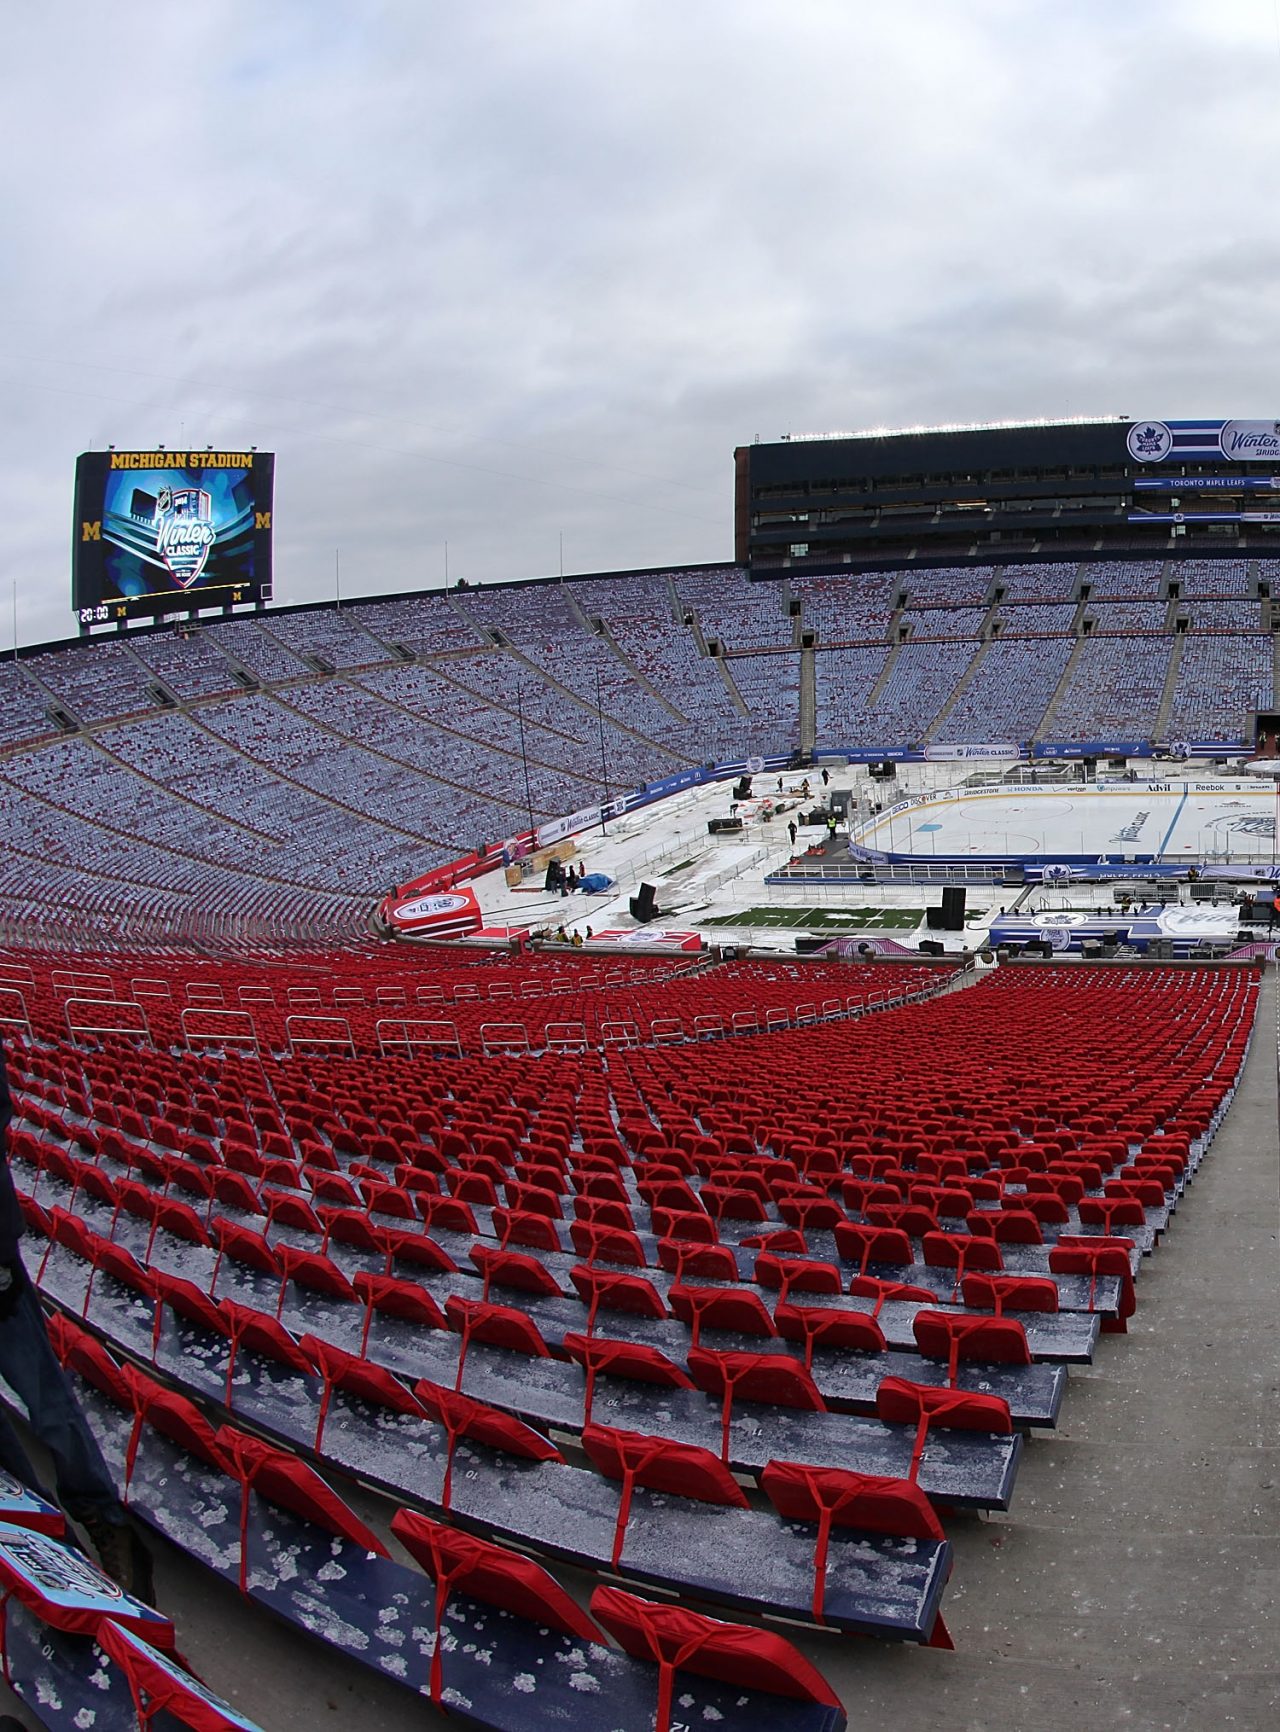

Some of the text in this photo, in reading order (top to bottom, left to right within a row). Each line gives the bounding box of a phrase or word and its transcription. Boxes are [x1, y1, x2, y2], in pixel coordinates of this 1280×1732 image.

[1229, 431, 1280, 451] Winter
[111, 454, 253, 469] MICHIGAN STADIUM
[255, 512, 271, 529] M
[82, 522, 101, 541] M
[157, 517, 215, 554] Winter
[167, 545, 200, 556] CLASSIC
[80, 606, 109, 622] 20:00
[965, 746, 990, 757] Winter
[892, 801, 909, 814] GEICO
[964, 788, 1000, 796] BRIDGESTONE
[1146, 784, 1171, 792] Advil
[978, 1382, 991, 1390] 12
[607, 1399, 619, 1407] 10
[464, 1469, 477, 1480] 10
[42, 1644, 55, 1660] 10
